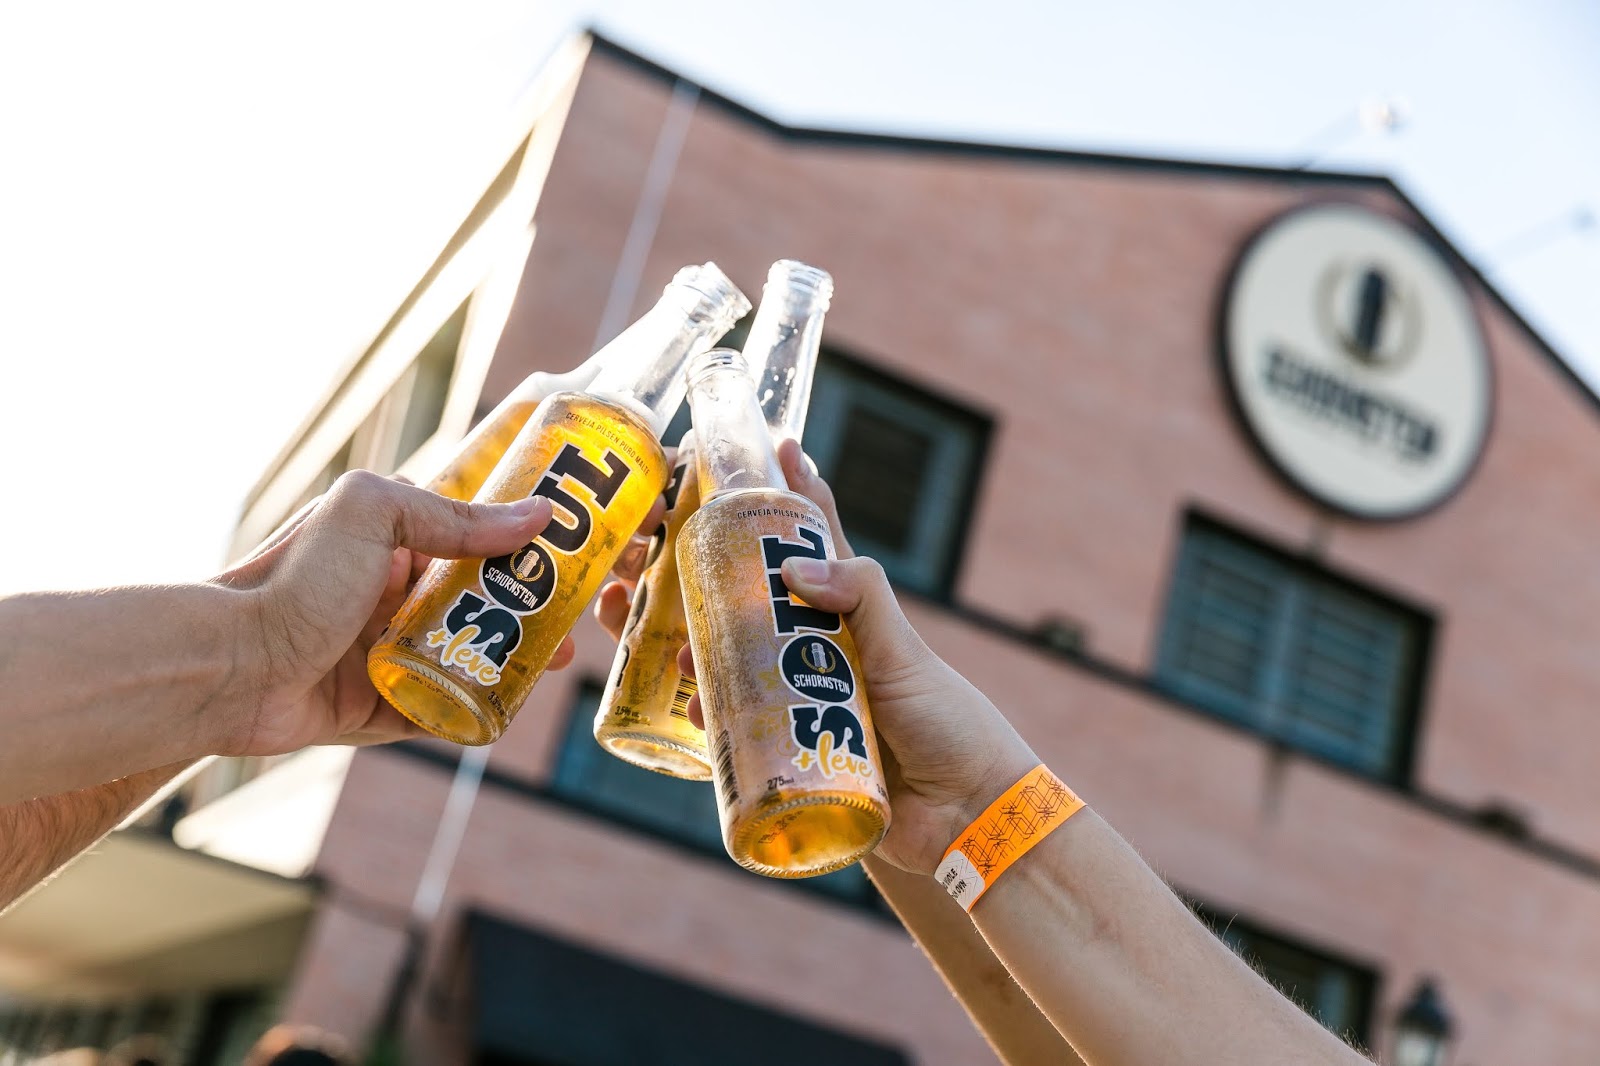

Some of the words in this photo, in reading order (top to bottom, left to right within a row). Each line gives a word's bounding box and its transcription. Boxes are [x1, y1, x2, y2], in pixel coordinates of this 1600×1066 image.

[565, 412, 595, 428] CERVEJA
[596, 424, 619, 444] PILSEN
[619, 441, 636, 458] PURO
[635, 455, 650, 476] MALTE
[737, 508, 771, 519] CERVEJA
[773, 508, 799, 519] PILSEN
[800, 513, 816, 525] PURO
[485, 566, 538, 609] SCHORNSTEIN
[793, 674, 851, 695] SCHORNSTEIN
